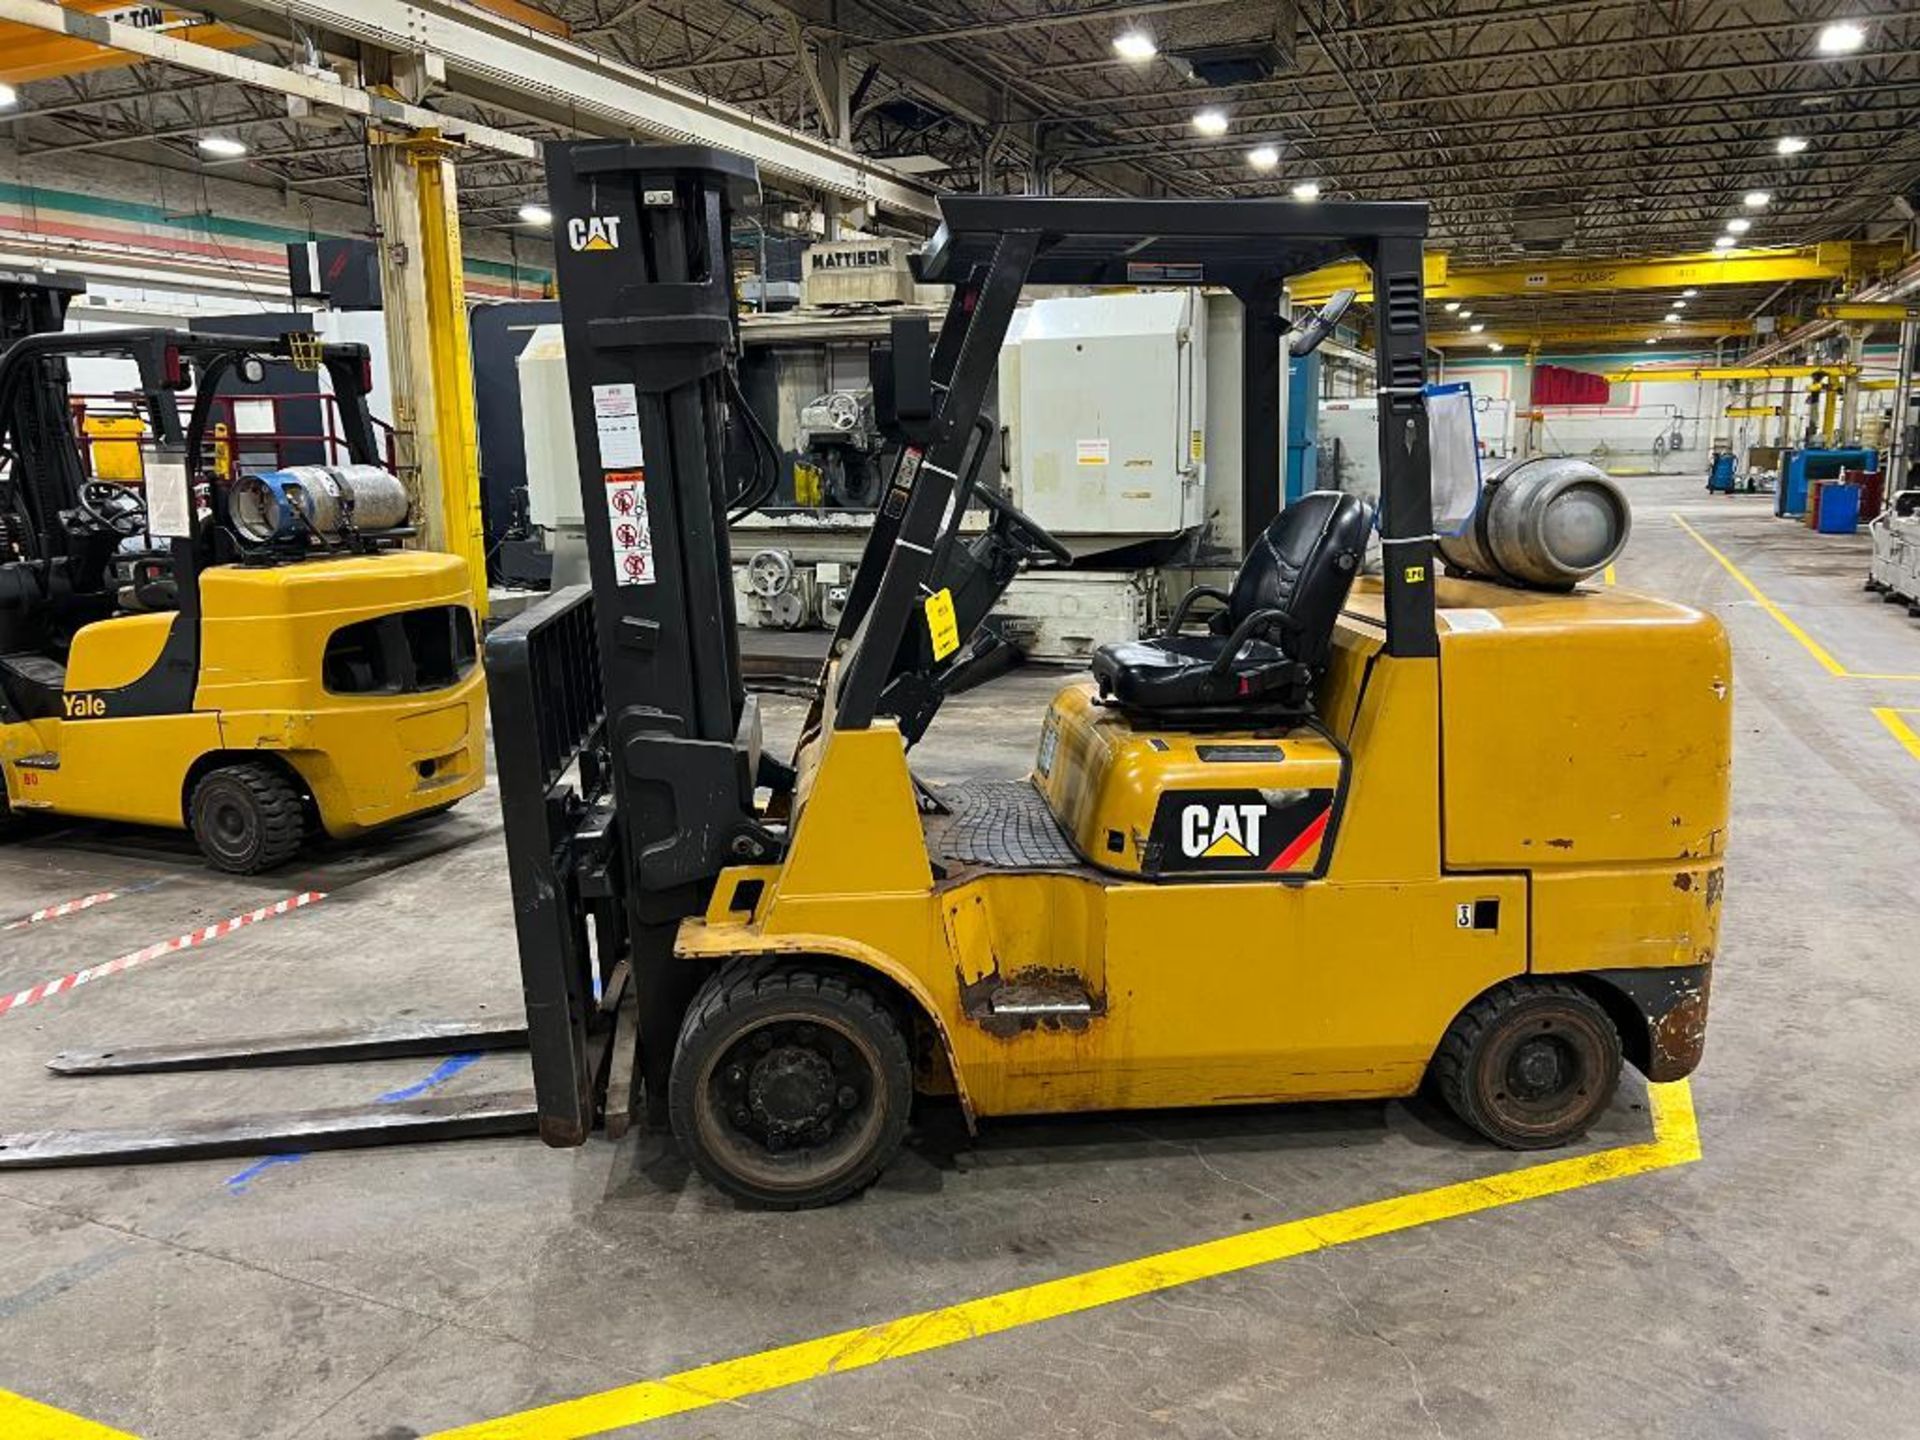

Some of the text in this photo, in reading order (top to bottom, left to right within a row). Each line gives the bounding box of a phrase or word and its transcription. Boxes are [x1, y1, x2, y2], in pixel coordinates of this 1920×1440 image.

[129, 7, 163, 29] TON
[568, 216, 620, 251] CAT
[812, 249, 892, 269] MATTISON
[62, 694, 106, 717] Yale
[1182, 804, 1267, 858] CAT
